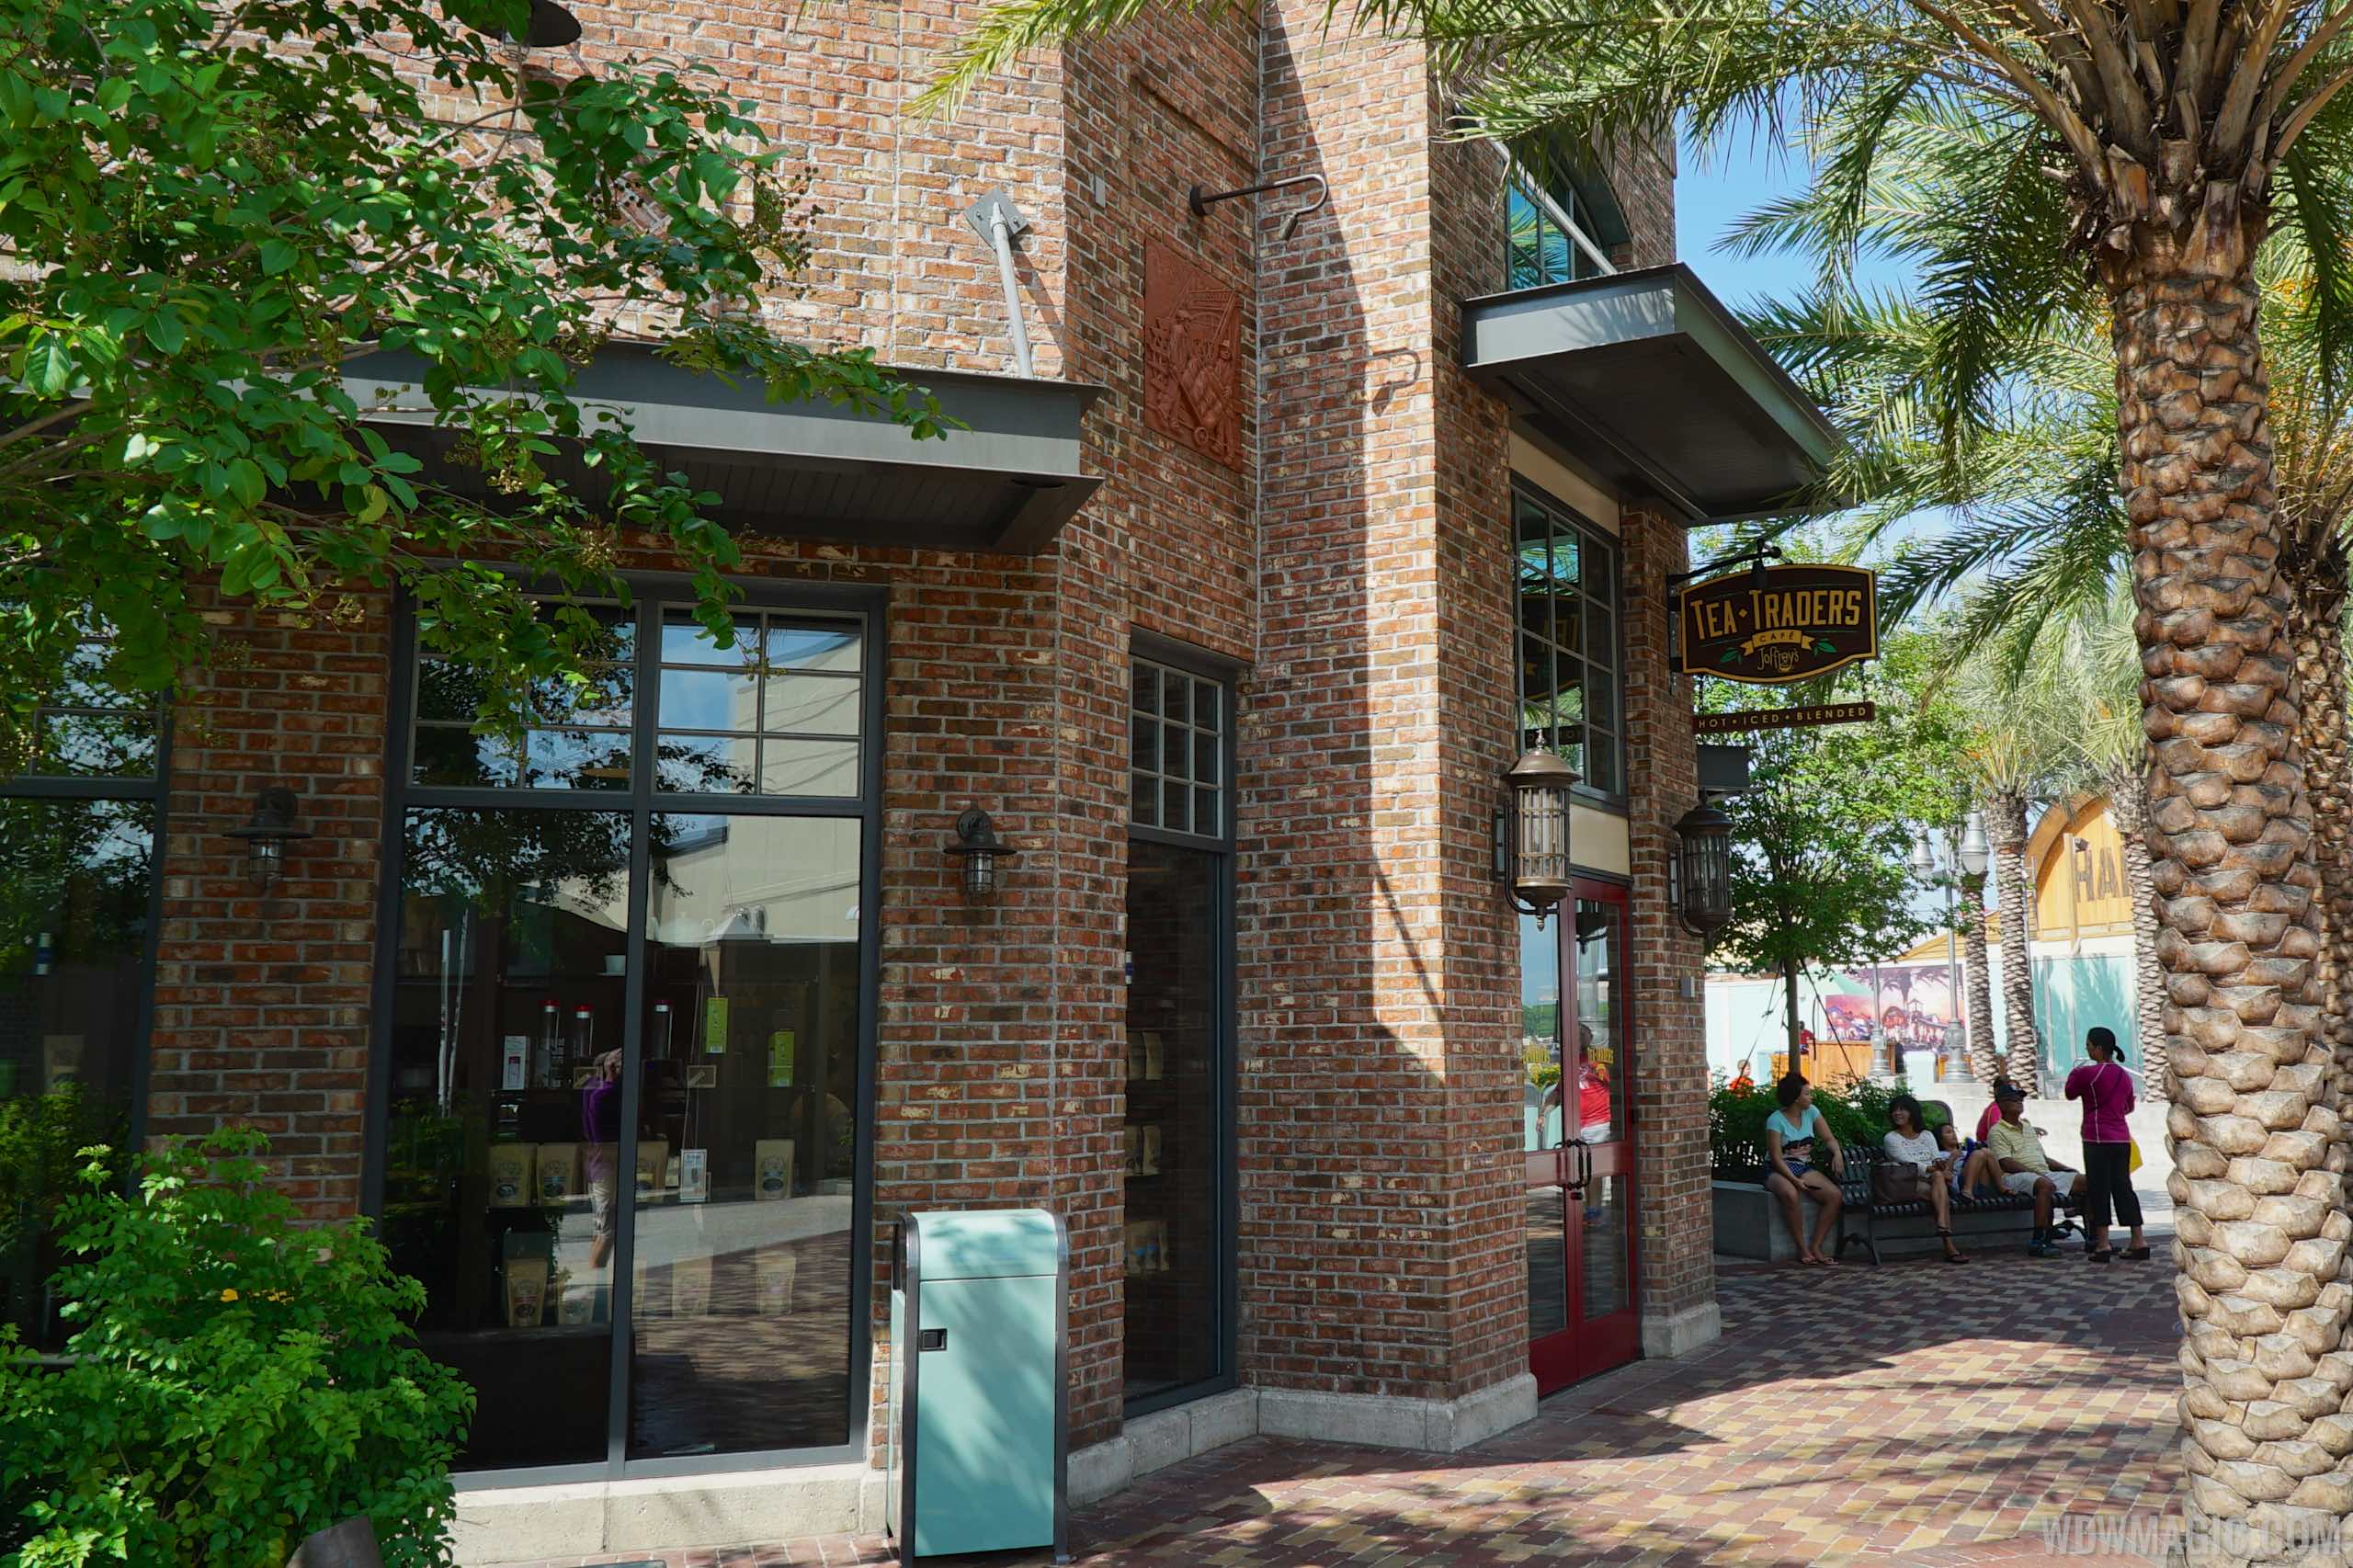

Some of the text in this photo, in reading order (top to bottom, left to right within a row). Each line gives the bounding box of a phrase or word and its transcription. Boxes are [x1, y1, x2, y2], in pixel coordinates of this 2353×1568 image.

[1749, 589, 1862, 630] TRADERS
[1759, 631, 1796, 642] CAFÉ
[1756, 646, 1800, 671] Joffrey's
[1699, 706, 1867, 729] HOT ICED BLENDED
